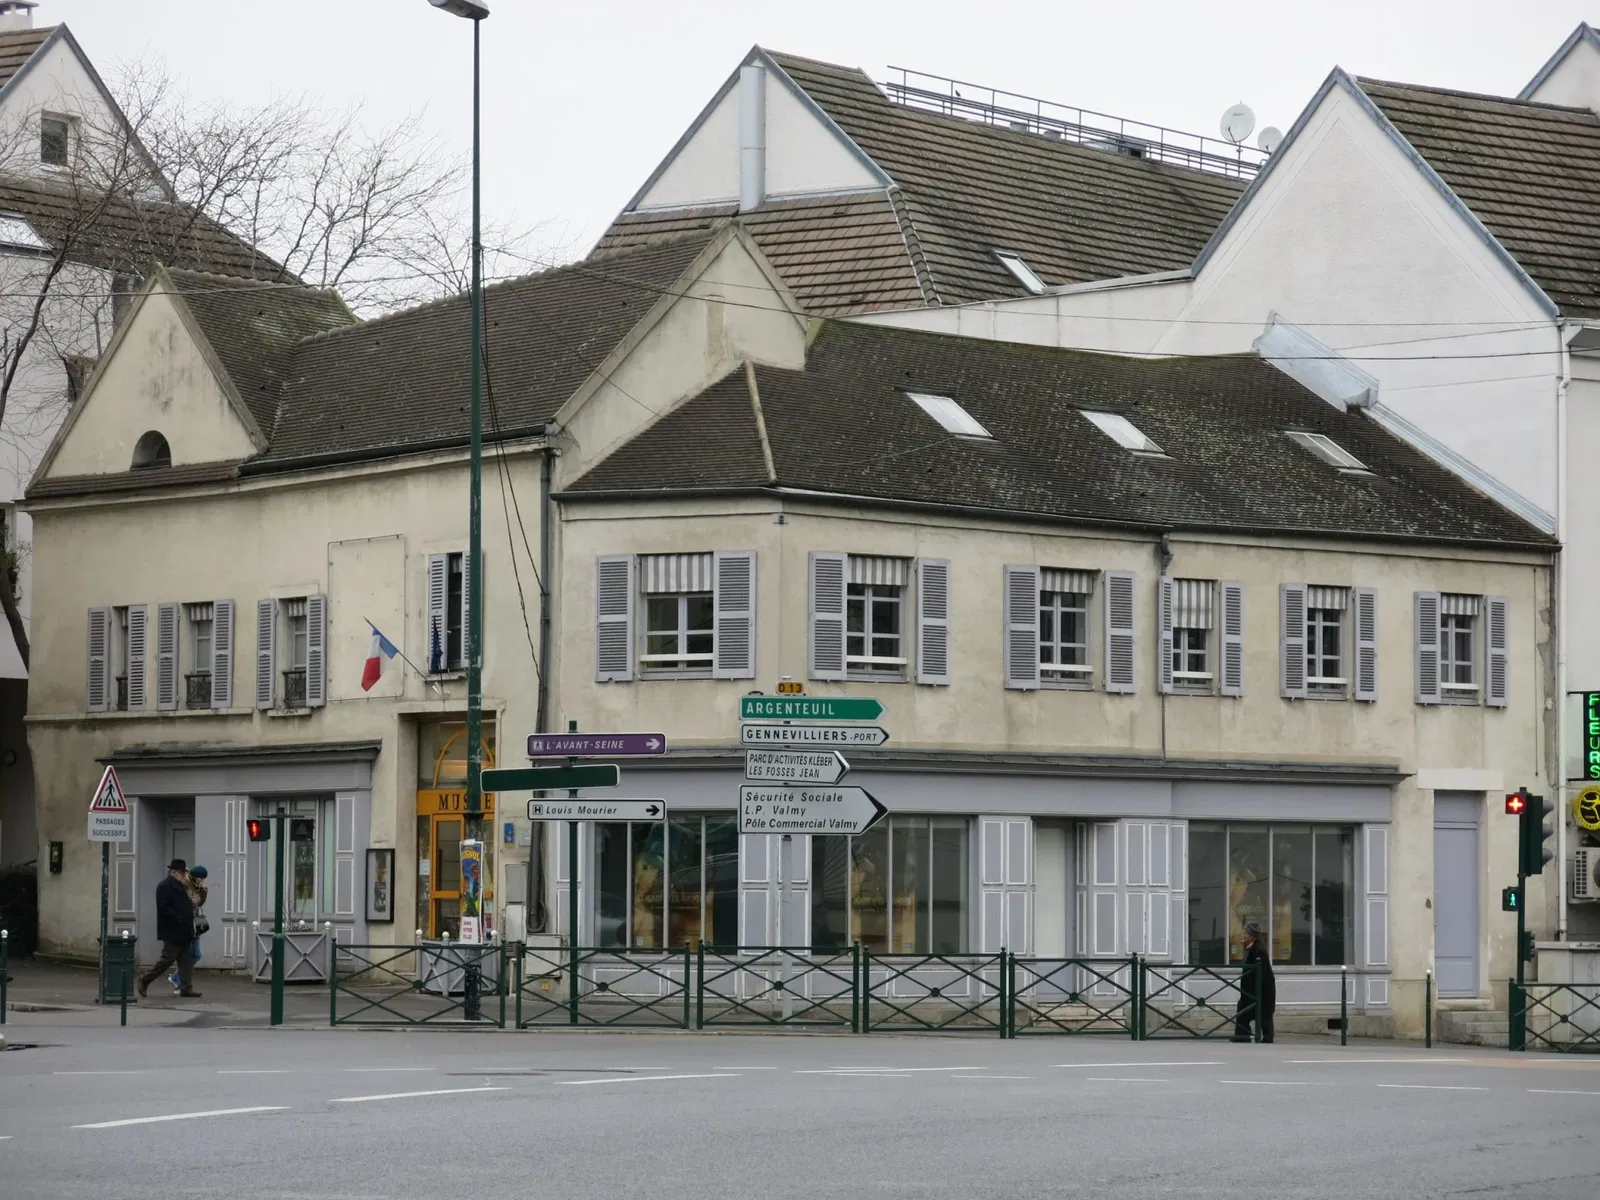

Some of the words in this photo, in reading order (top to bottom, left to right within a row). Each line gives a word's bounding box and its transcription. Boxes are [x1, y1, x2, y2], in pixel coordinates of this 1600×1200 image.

[779, 683, 786, 693] D
[789, 683, 802, 693] 13
[746, 702, 835, 715] ARGENTEUIL
[746, 729, 848, 741] GENNEVILLIERS
[1589, 693, 1600, 779] FLEURS
[546, 740, 625, 750] L'AVANT-SEINE
[749, 753, 767, 763] PARC
[767, 754, 808, 766] D'ACTIVITÉS
[808, 754, 833, 767] KLÉBER
[749, 766, 763, 776] LES
[766, 767, 796, 778] FOSSES
[799, 769, 820, 779] JEAN
[438, 793, 492, 810] MUSE
[745, 791, 795, 802] Sécurité
[800, 792, 843, 802] Sociale
[546, 805, 573, 815] Louis
[577, 806, 618, 815] Mourier
[745, 805, 766, 815] L.P.
[772, 805, 806, 816] Valmy
[95, 818, 125, 826] PASSAGES
[745, 818, 767, 828] Pôle
[768, 818, 826, 829] Commercial
[828, 819, 858, 830] Valmy
[92, 829, 127, 837] SUCCESSIFS
